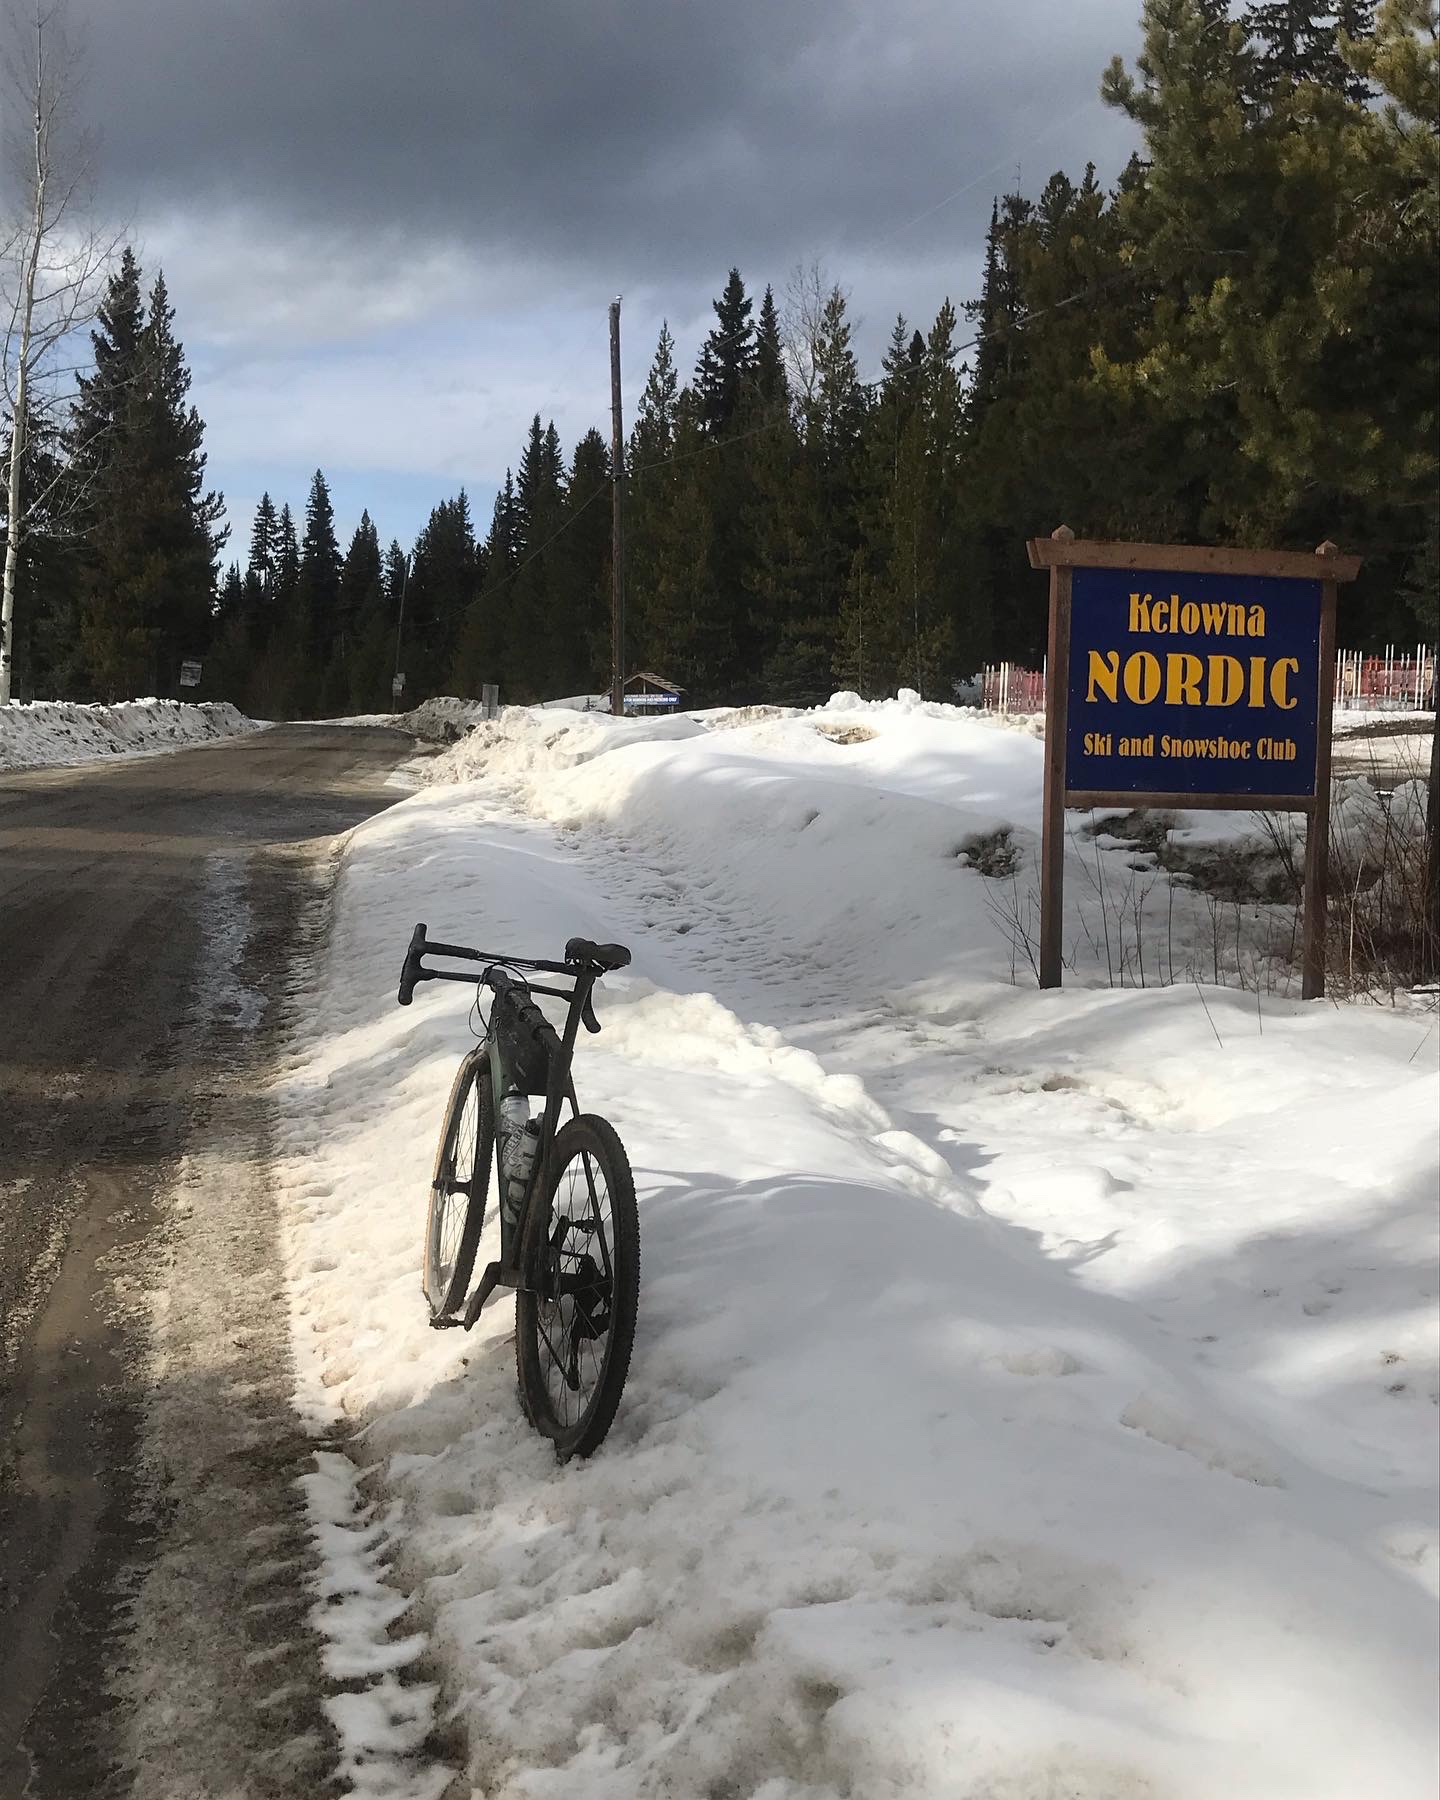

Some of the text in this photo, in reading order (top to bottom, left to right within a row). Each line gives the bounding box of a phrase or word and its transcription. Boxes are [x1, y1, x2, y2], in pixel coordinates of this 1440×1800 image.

[1128, 593, 1266, 637] Kelowna
[1085, 650, 1300, 710] NORDIC
[1083, 732, 1297, 761] Ski and Snowshoe Club
